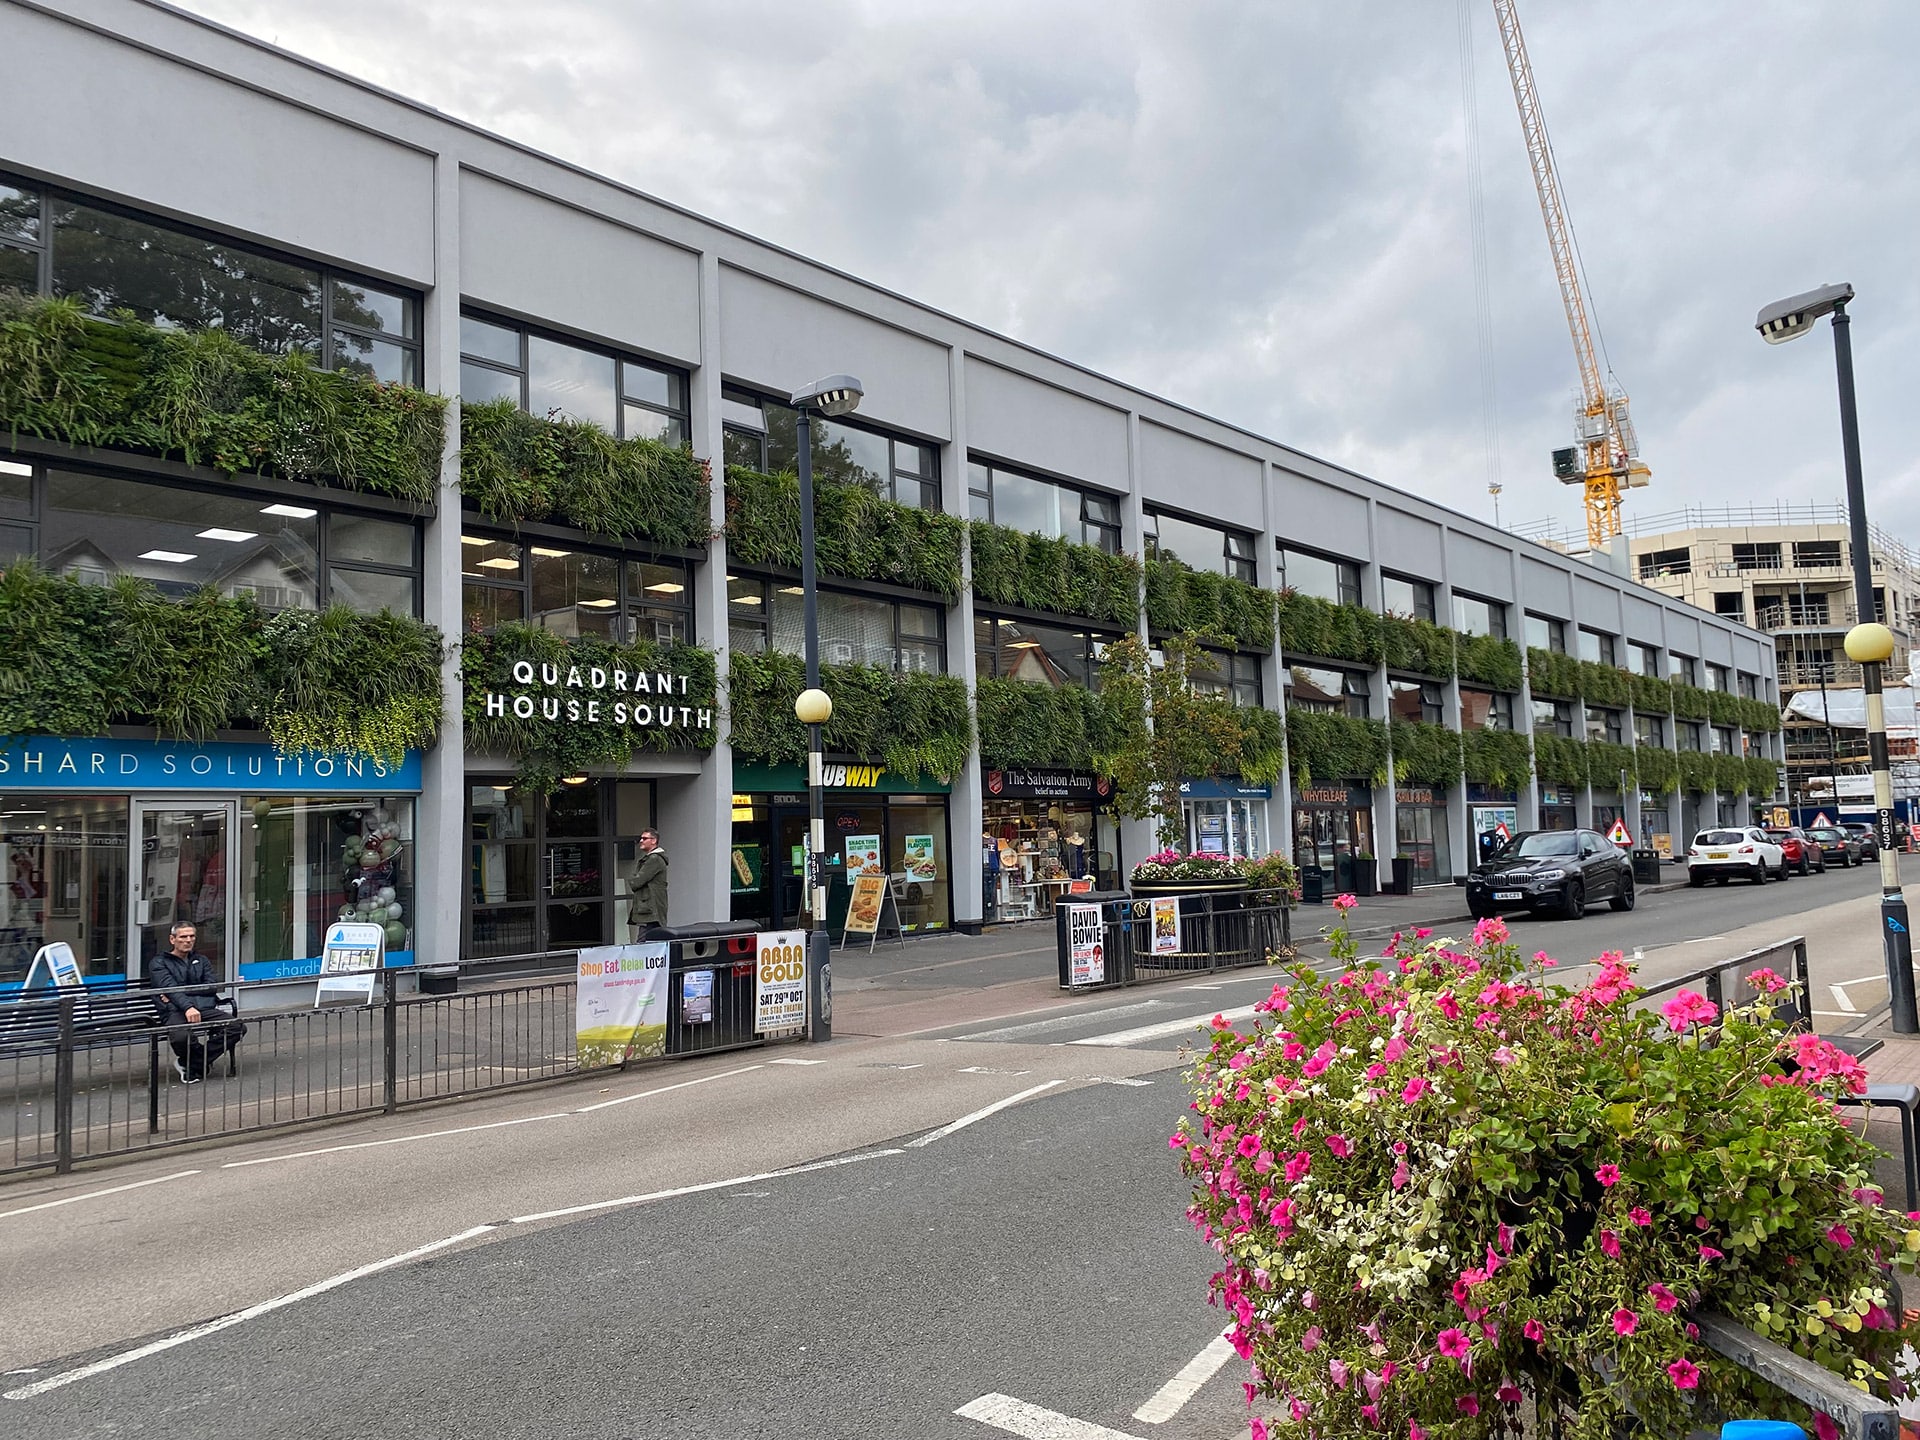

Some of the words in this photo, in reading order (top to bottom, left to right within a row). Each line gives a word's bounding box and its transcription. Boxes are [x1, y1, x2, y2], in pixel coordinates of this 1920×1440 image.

[513, 661, 688, 695] QUADRANT
[487, 694, 599, 722] HOUSE
[615, 703, 711, 728] SOUTH
[0, 752, 139, 775] SHARD
[163, 754, 387, 777] SOLUTIONS
[822, 765, 881, 788] UBWAY
[1007, 771, 1025, 785] The
[1027, 770, 1067, 786] Salvation
[1069, 774, 1092, 790] Army
[1302, 790, 1348, 802] WHYTELEAFE
[836, 817, 861, 828] OPEN
[1880, 809, 1890, 849] 08637
[860, 880, 879, 890] BIG
[1072, 911, 1098, 928] DAVID
[1073, 927, 1102, 944] BOWIE
[761, 945, 803, 966] ABBA
[581, 962, 603, 978] Shop
[605, 959, 620, 974] Eat
[621, 958, 645, 972] Relax
[645, 954, 667, 970] Local
[760, 962, 803, 983] GOLD
[760, 994, 774, 1006] SAT
[789, 990, 804, 1003] OCT
[760, 1007, 769, 1016] THE
[770, 1005, 782, 1015] STAG
[783, 1003, 804, 1013] THEATRE
